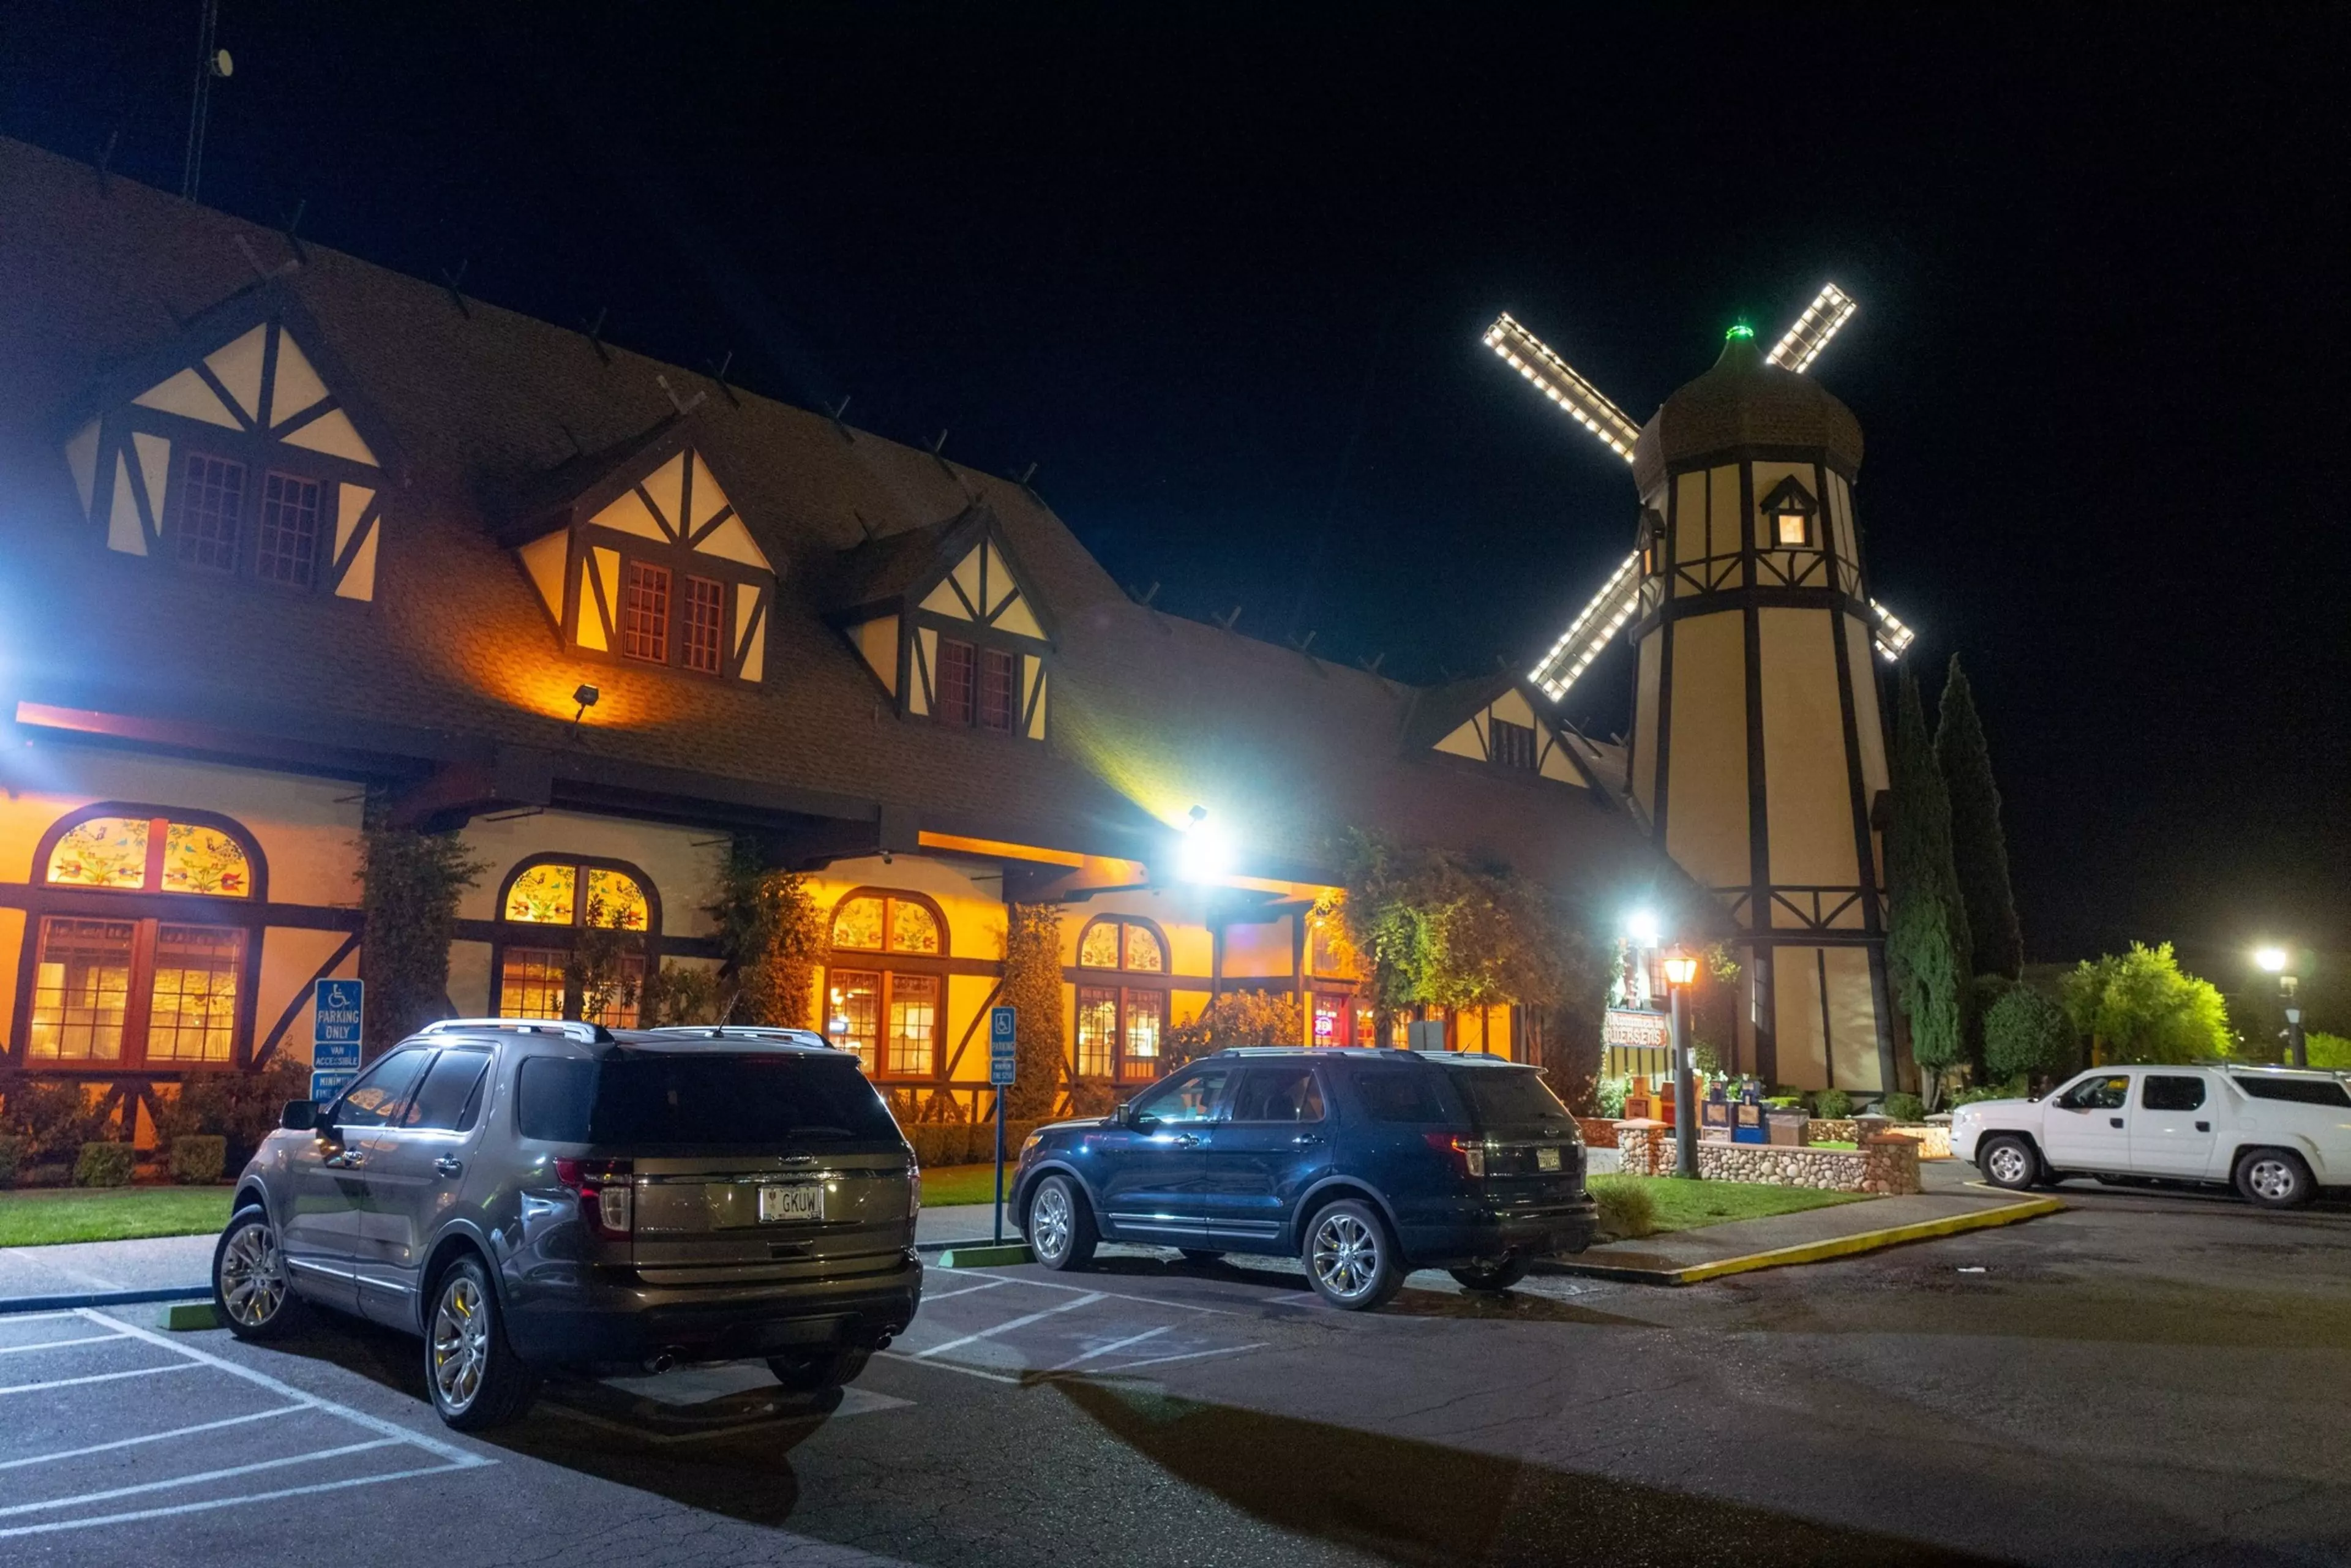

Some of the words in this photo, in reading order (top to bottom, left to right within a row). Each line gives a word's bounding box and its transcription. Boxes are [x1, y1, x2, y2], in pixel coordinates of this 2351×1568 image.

[318, 1010, 359, 1024] PARKING
[325, 1026, 350, 1039] ONLY
[331, 1046, 345, 1055] VAN
[316, 1057, 358, 1065] ACCESSIBLE
